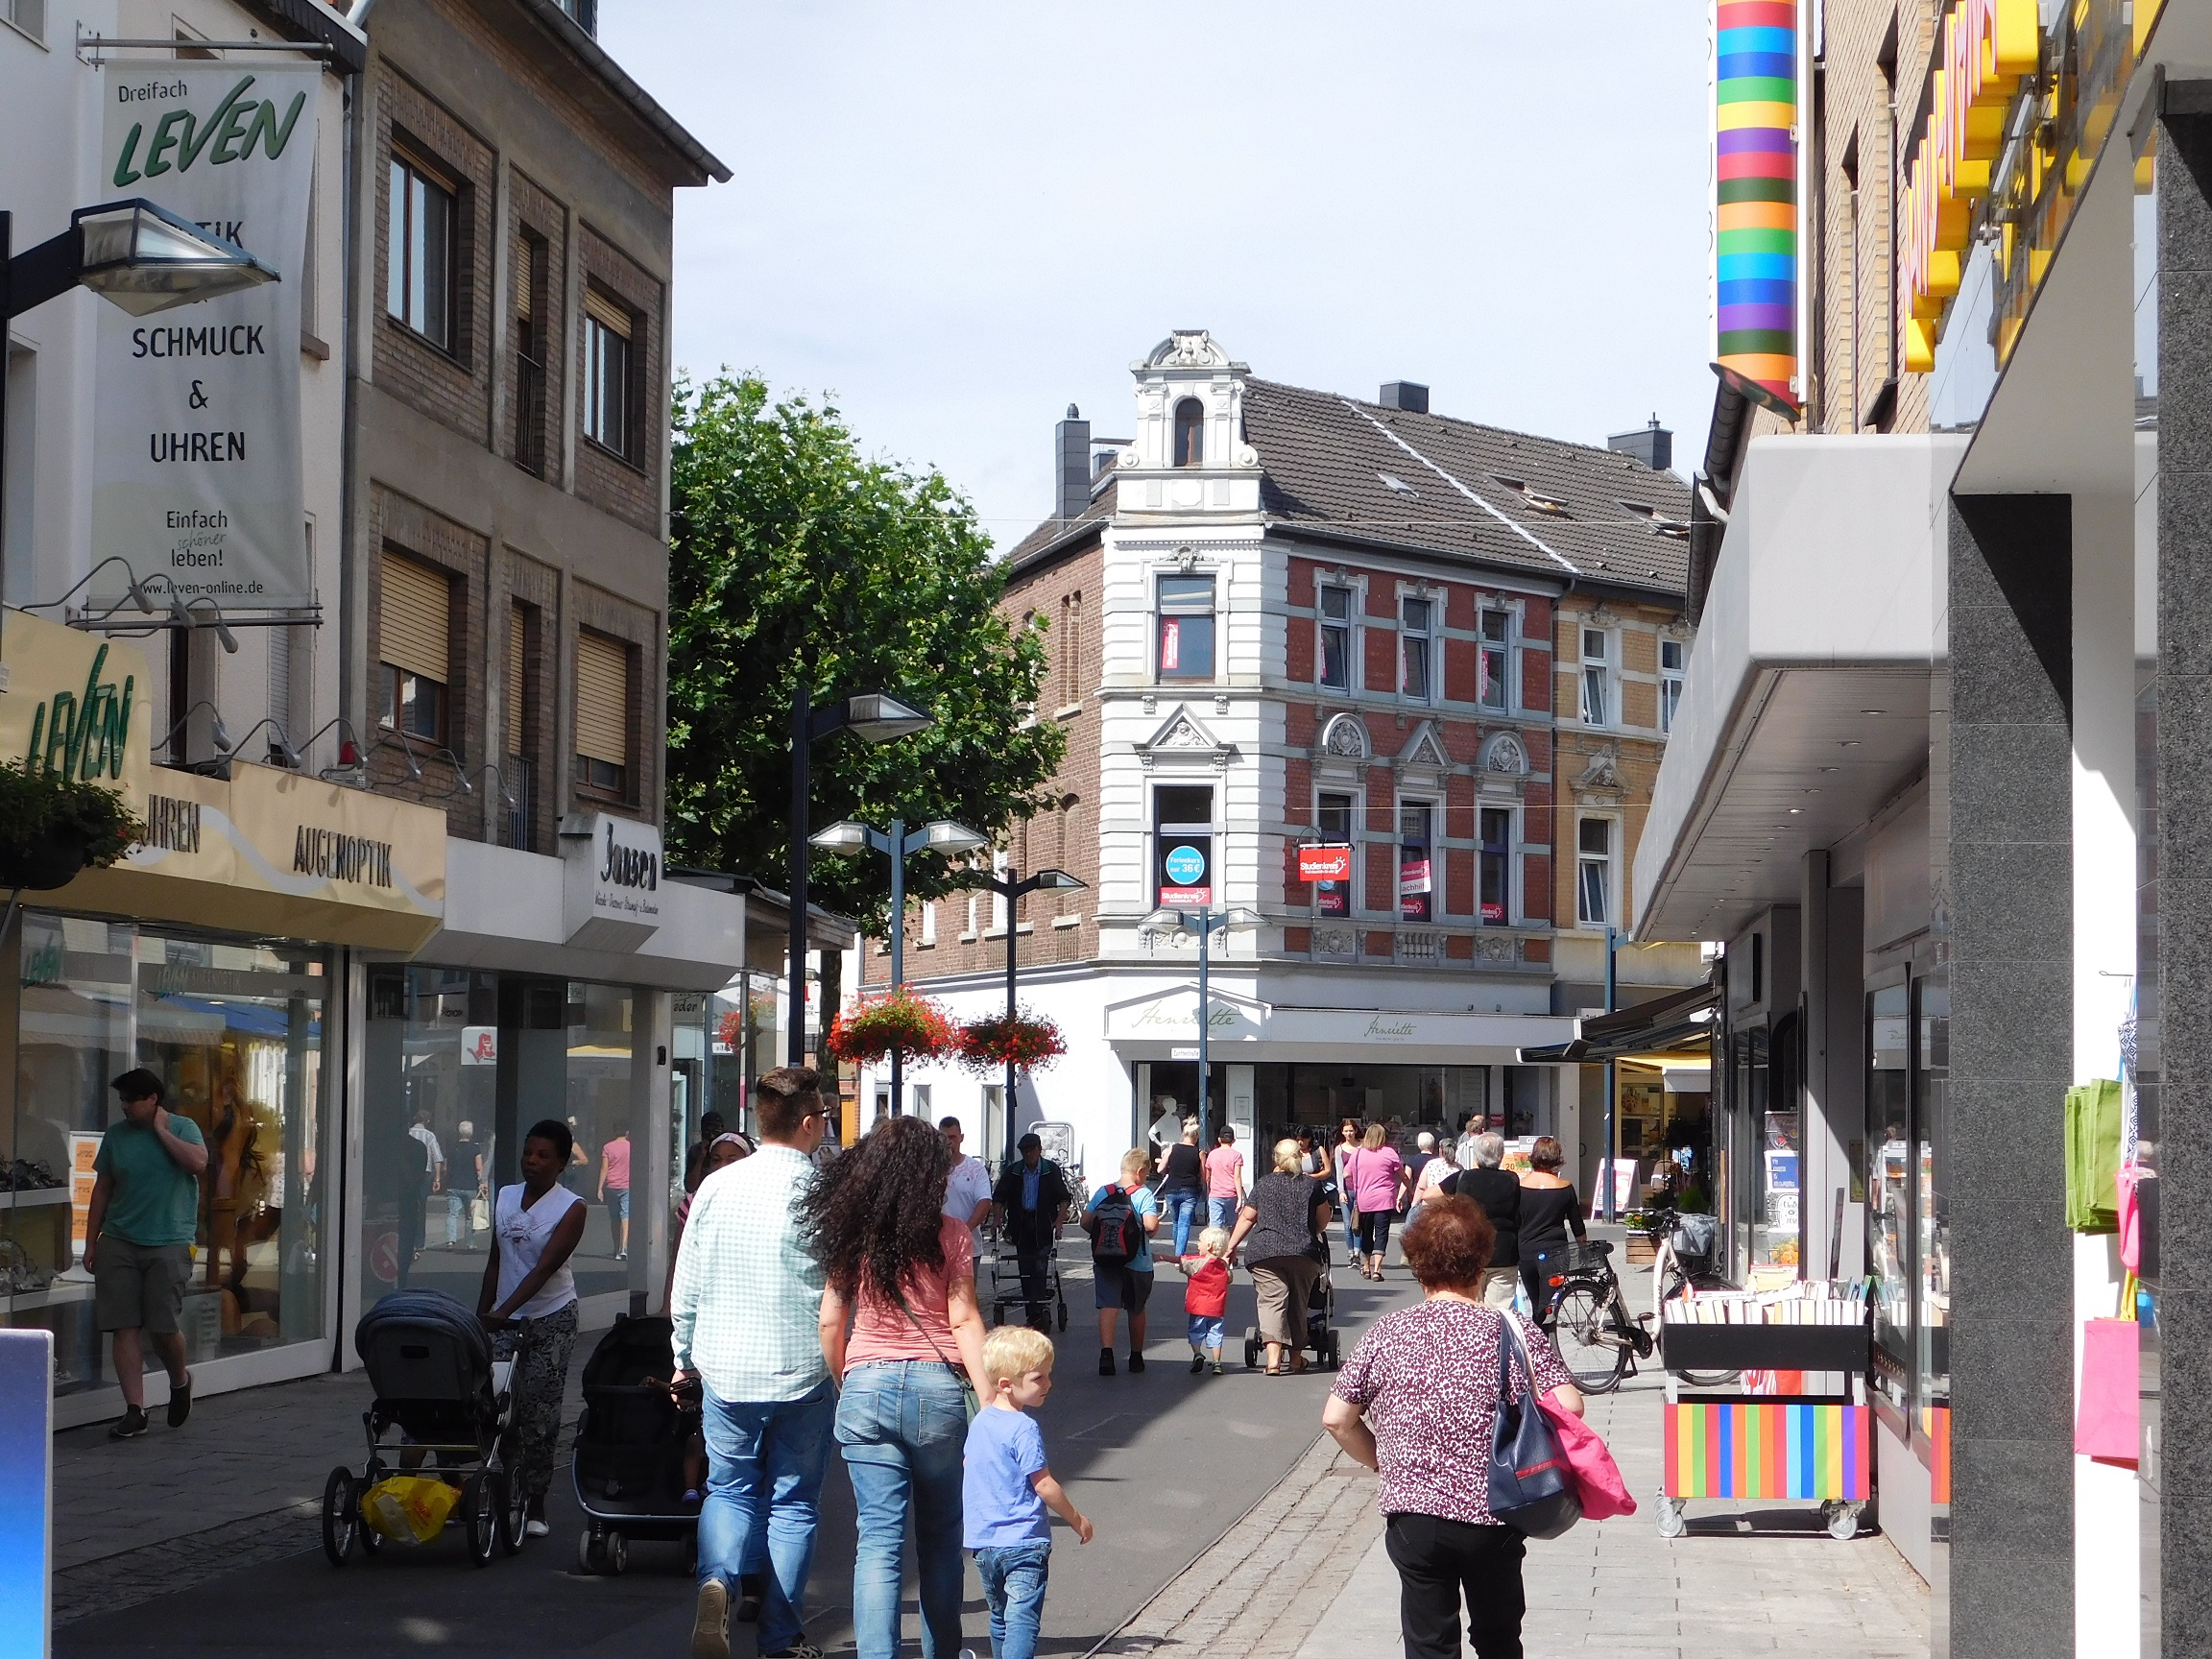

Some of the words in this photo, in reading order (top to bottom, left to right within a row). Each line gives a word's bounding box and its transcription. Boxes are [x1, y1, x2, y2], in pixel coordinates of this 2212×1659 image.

[118, 79, 188, 103] Dreifach
[113, 74, 307, 188] LEVEN
[132, 325, 266, 358] SCHMUCK
[188, 379, 209, 410] &
[150, 431, 247, 464] UHREN
[166, 510, 228, 529] Einfach
[177, 531, 228, 551] schöner
[171, 549, 224, 566] leben!
[27, 642, 134, 781] LEVEN
[293, 825, 393, 889] AUGENOPTIK
[1300, 861, 1339, 871] Studienkreis
[1363, 1015, 1418, 1037] Henriette
